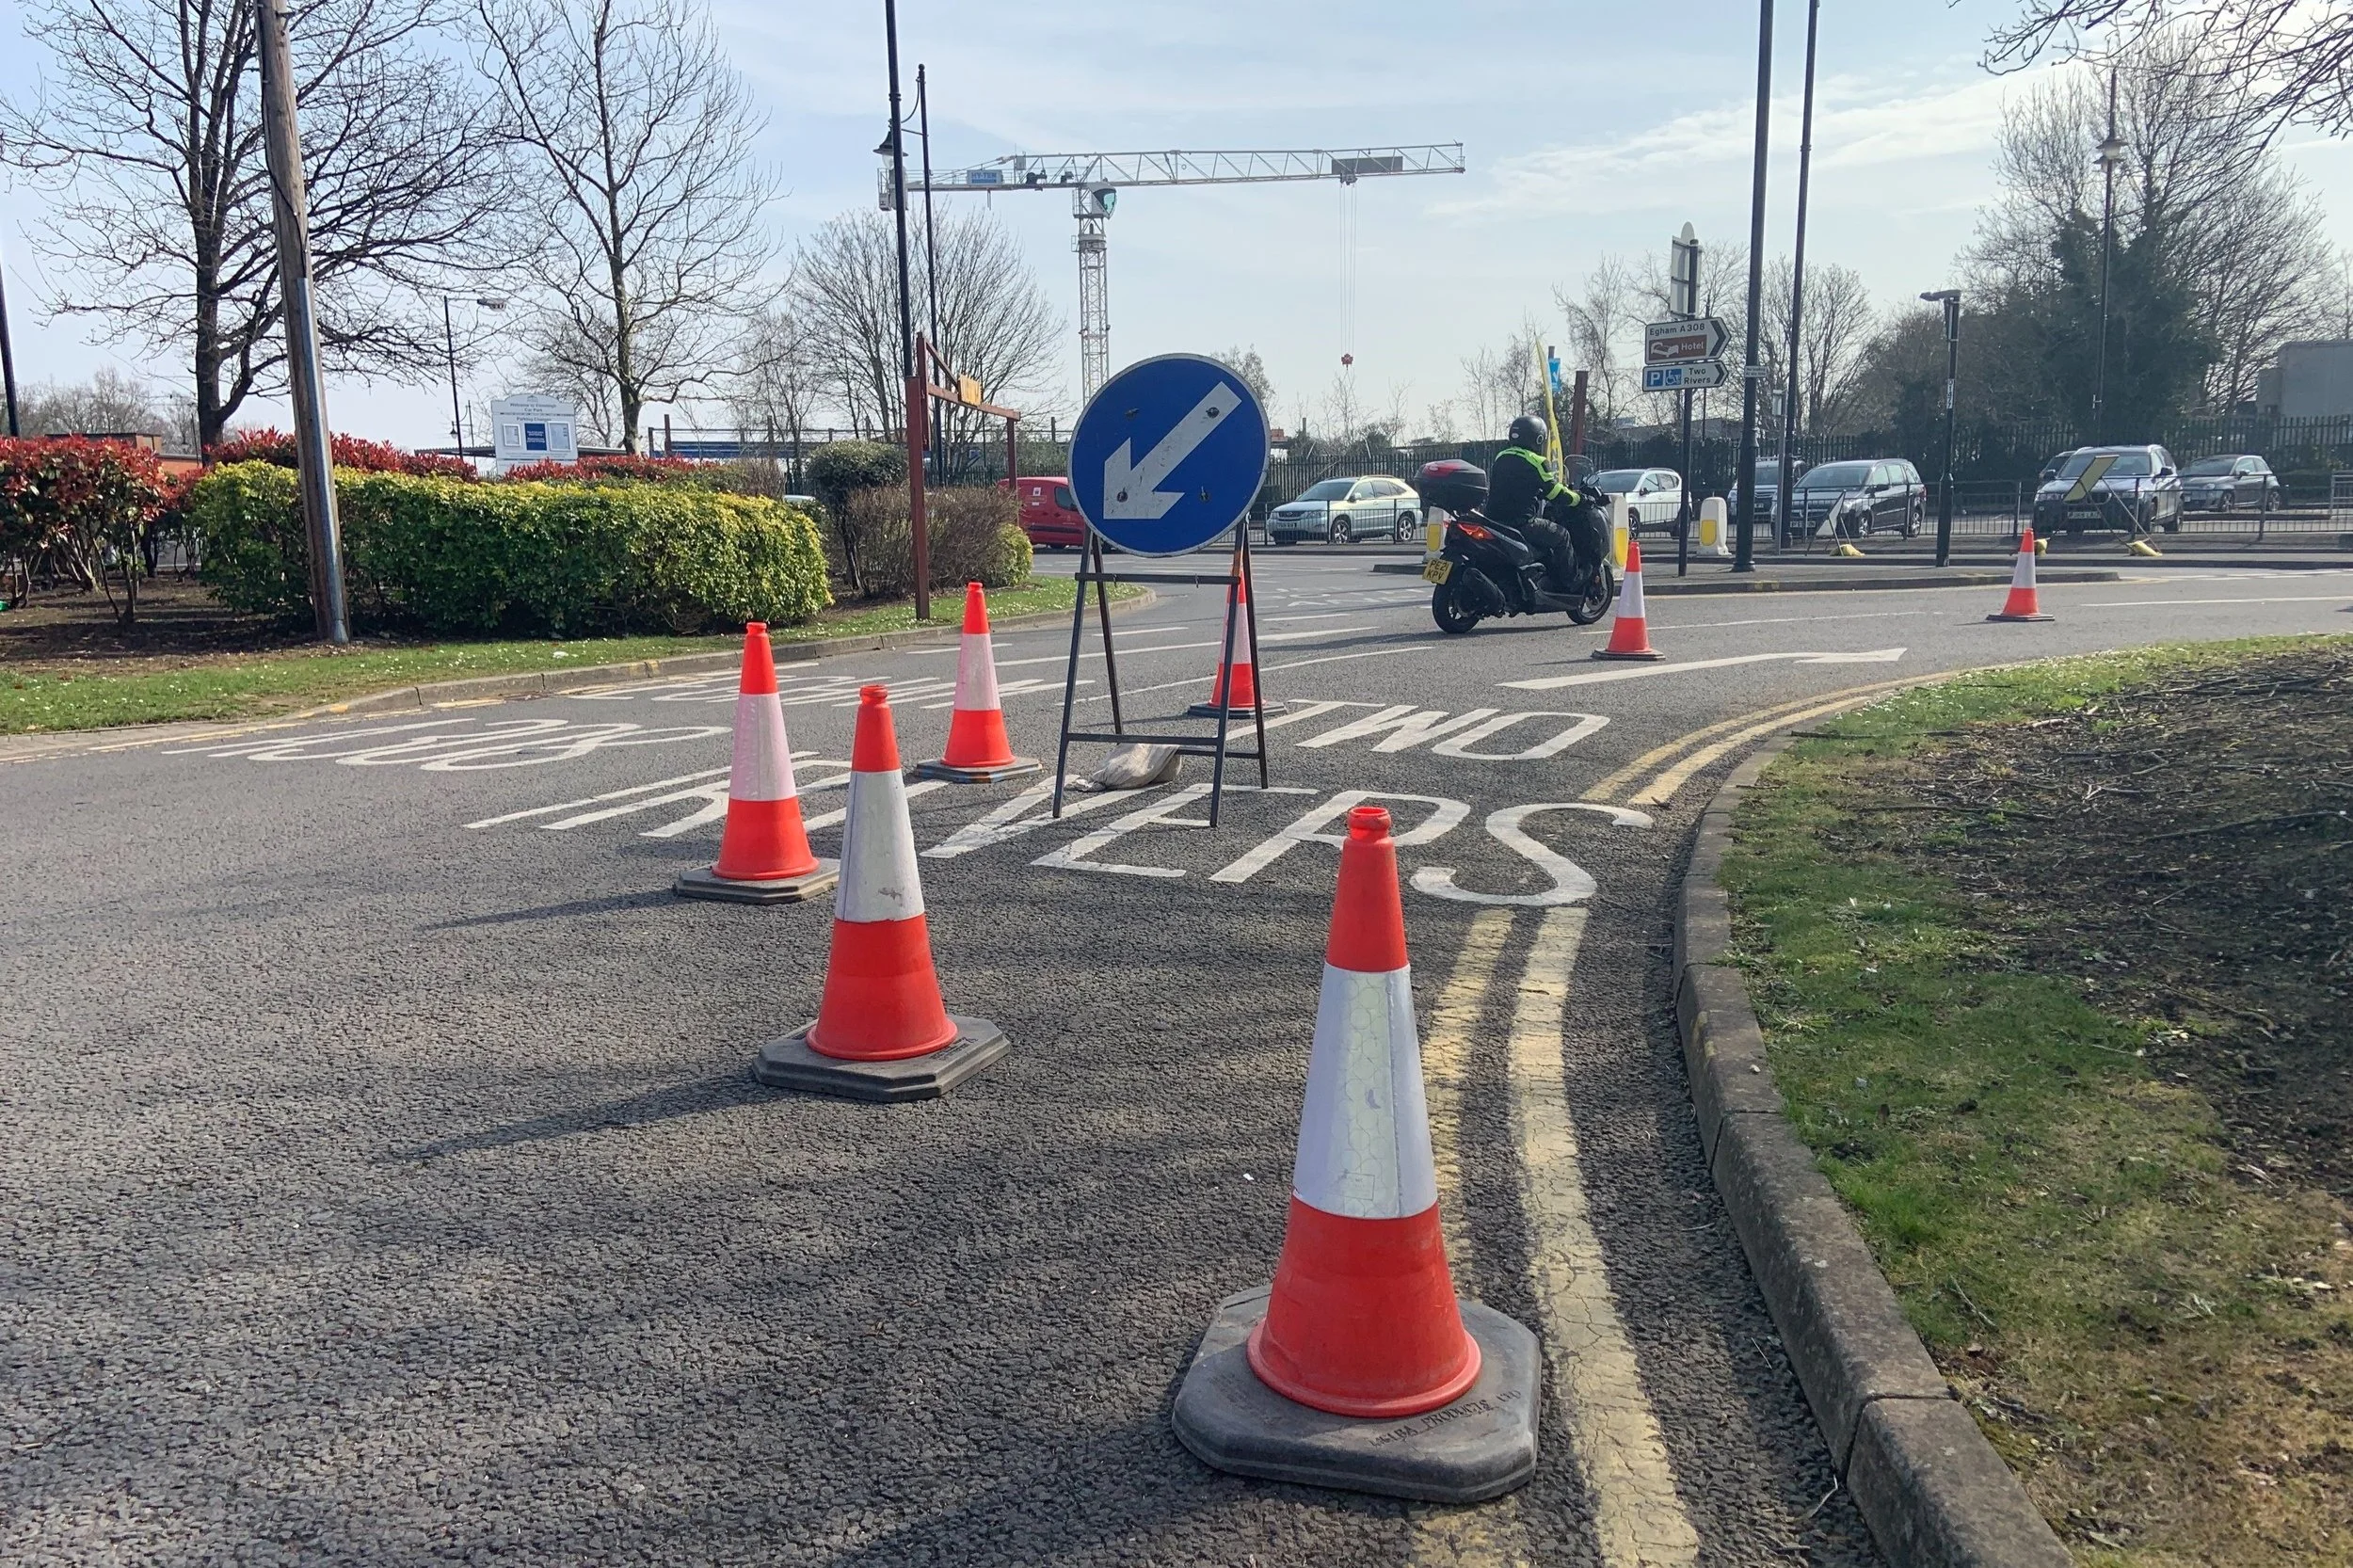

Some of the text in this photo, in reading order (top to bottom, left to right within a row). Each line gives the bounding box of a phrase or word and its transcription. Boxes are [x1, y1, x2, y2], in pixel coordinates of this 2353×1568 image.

[1649, 323, 1705, 337] Egham A308
[1681, 341, 1705, 351] Hotel
[1689, 367, 1706, 376] Two
[1650, 372, 1660, 385] P
[1430, 560, 1449, 572] PE21
[1427, 569, 1444, 580] KPV
[1225, 698, 1610, 760] TWO
